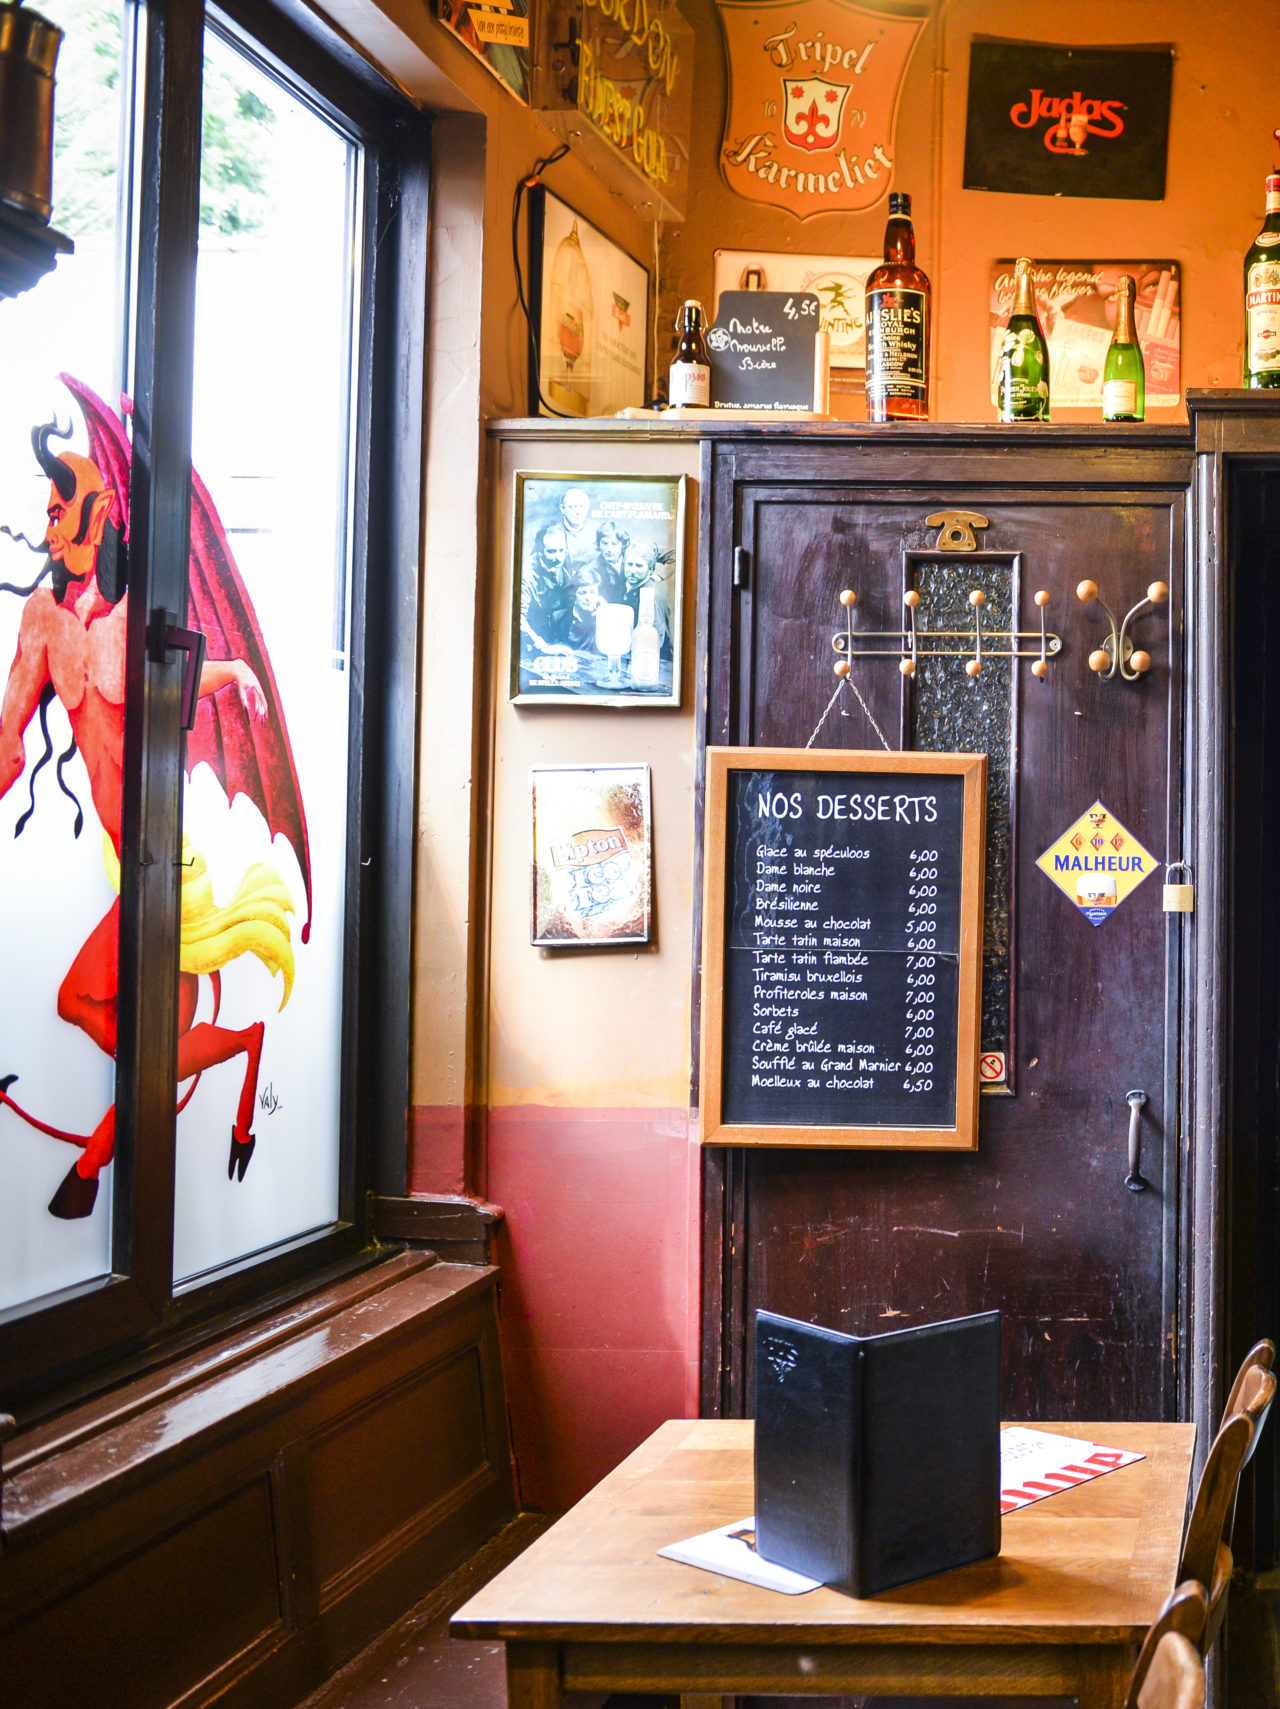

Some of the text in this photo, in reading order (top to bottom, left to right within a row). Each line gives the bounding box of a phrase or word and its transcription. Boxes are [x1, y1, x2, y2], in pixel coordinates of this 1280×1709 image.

[763, 21, 877, 74] Tripel
[1010, 88, 1127, 140] Judas
[724, 131, 892, 194] Karmeliet
[1055, 267, 1105, 286] legend
[729, 317, 773, 335] Notre
[758, 791, 938, 825] NOS DESSERTS
[557, 835, 623, 864] Lipton
[1094, 838, 1104, 847] 10
[1114, 837, 1124, 847] 12
[757, 845, 788, 859] Glace
[794, 848, 807, 858] au
[909, 850, 938, 863] 6,00
[756, 862, 938, 881] Dame blanche 6,00
[1054, 855, 1145, 873] MALHEUR
[756, 879, 937, 899] Dame noire 6,00
[755, 896, 937, 917] Brésilienne 6,00
[754, 915, 936, 934] Mousse au chocolat 5,00
[753, 932, 936, 952] Tarte tatin maison 6,00
[752, 951, 936, 970] Tarte tatin flambée 7,00
[752, 968, 935, 987] Tiramisu bruxellois 6,00
[753, 985, 935, 1005] Profiteroles maison 7,00
[753, 1003, 935, 1023] Sorbets 6,00
[752, 1021, 934, 1041] Café glacé 7,00
[837, 1041, 875, 1054] maison
[905, 1044, 934, 1058] 6,00
[801, 1061, 815, 1071] au
[820, 1057, 853, 1072] Grand
[859, 1058, 902, 1072] Marnier
[905, 1062, 933, 1076] 6,00
[751, 1074, 933, 1093] Moelleux au chocolat 6,50
